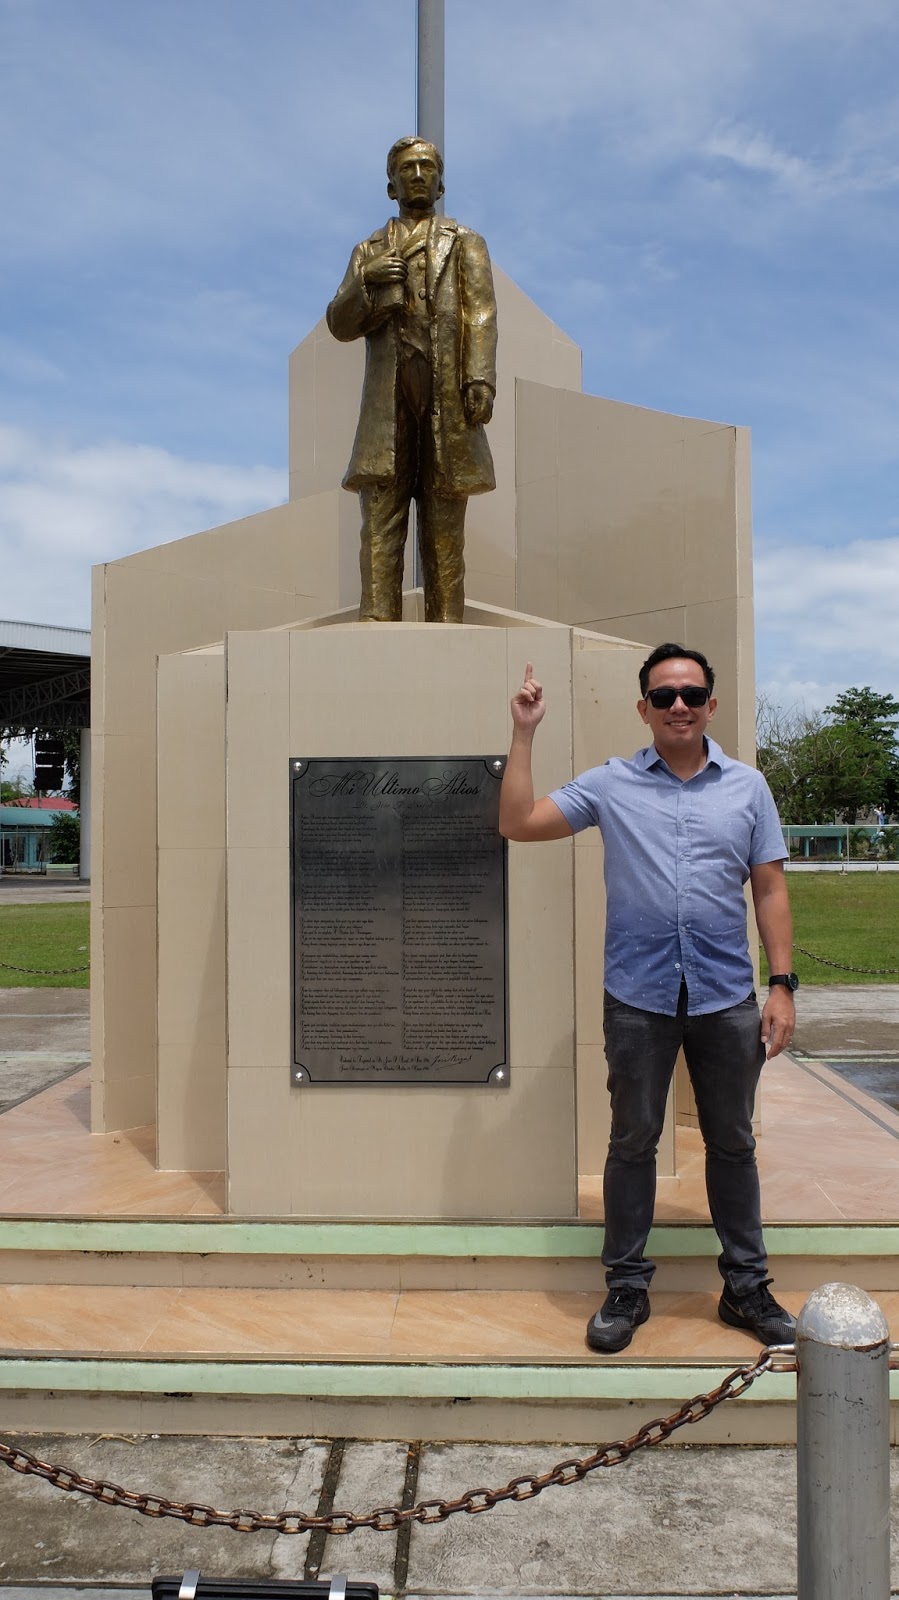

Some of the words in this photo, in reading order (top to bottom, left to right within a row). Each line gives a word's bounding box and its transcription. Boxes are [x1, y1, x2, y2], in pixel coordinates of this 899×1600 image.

[309, 773, 356, 797] Mi
[350, 770, 420, 798] Ultimo
[421, 770, 481, 802] Adios
